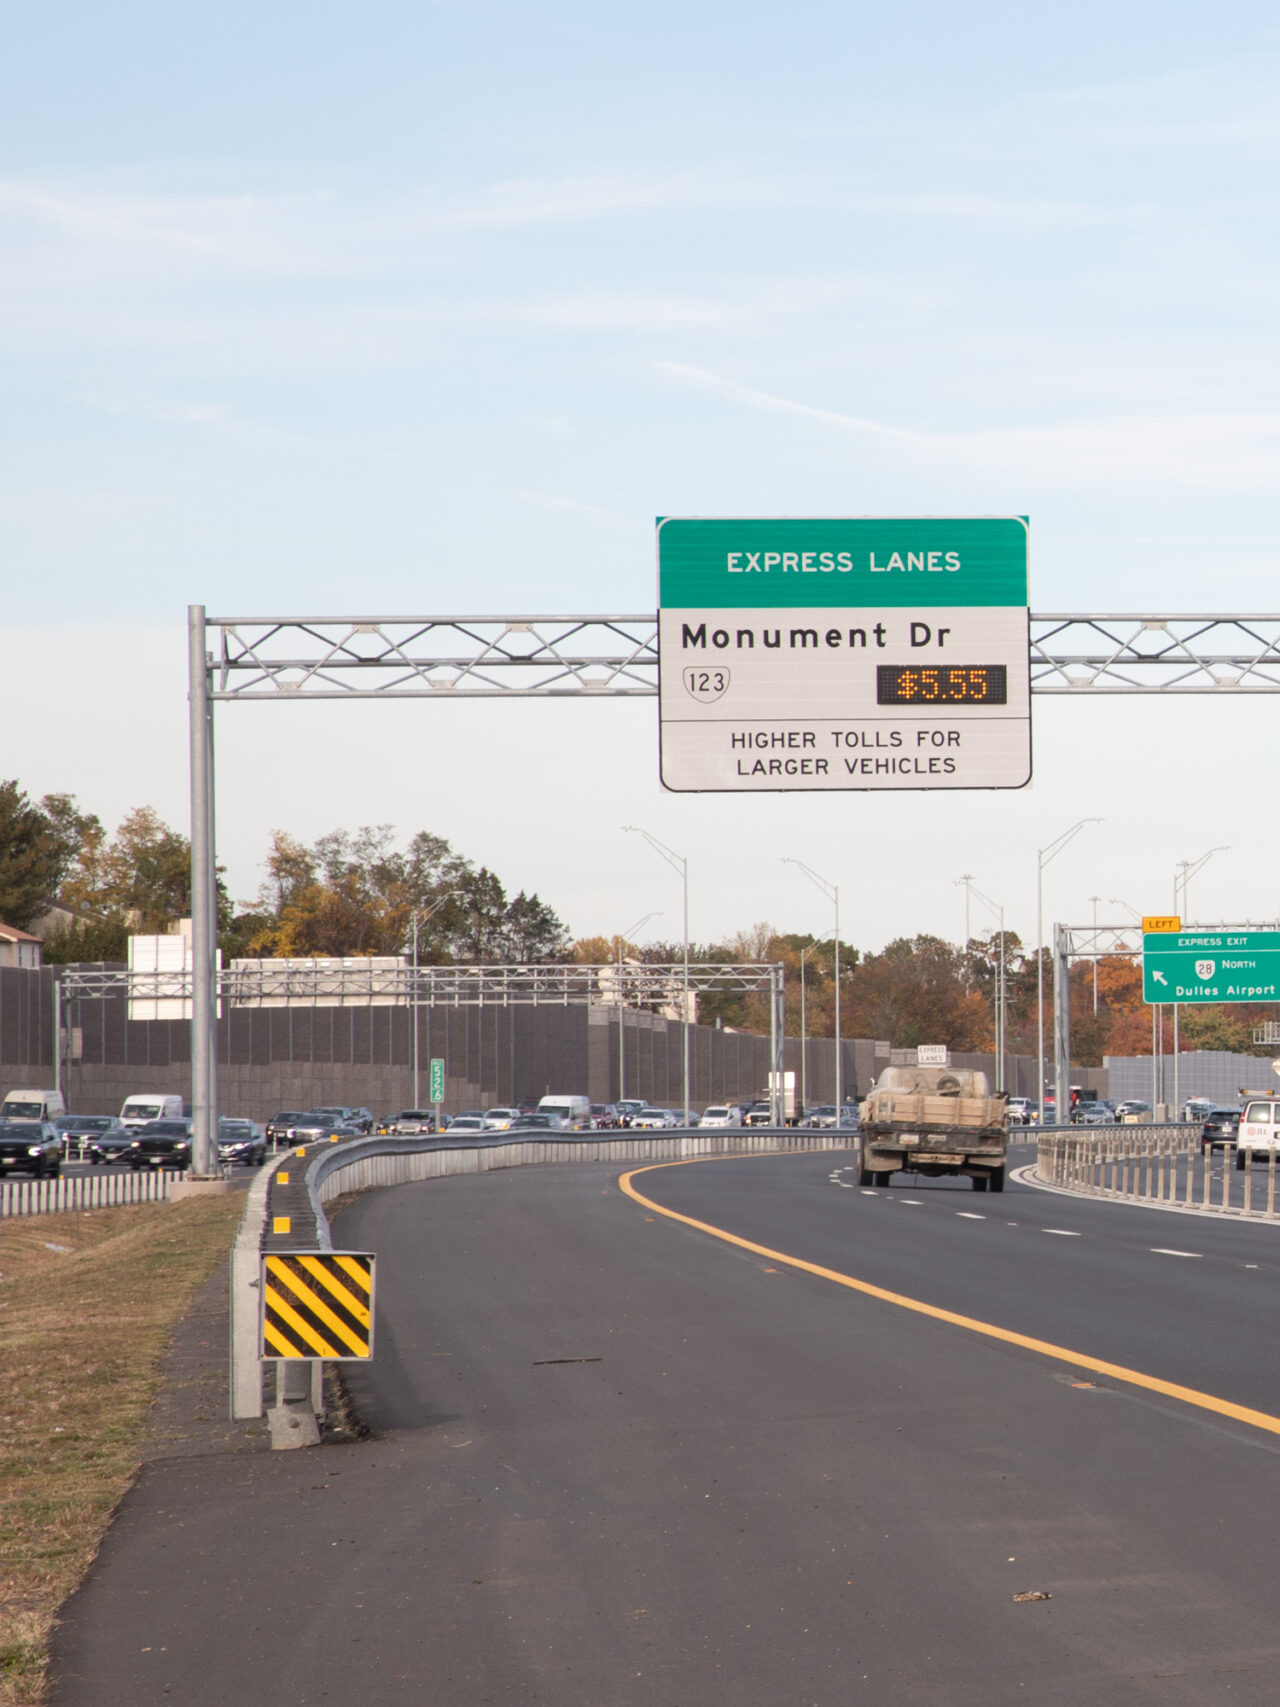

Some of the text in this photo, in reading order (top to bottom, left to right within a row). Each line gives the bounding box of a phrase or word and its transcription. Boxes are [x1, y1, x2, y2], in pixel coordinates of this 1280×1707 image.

[727, 551, 961, 573] EXPRESS LANES
[682, 622, 951, 649] Monument Dr
[690, 673, 724, 692] 123
[897, 670, 988, 699] $5.55
[732, 731, 961, 748] HIGHER TOLLS FOR
[738, 758, 956, 775] LARGER VEHICLES
[1178, 938, 1222, 947] EXPRESS
[1199, 960, 1256, 974] 28 NORTH
[1176, 986, 1275, 997] Dulles Airport
